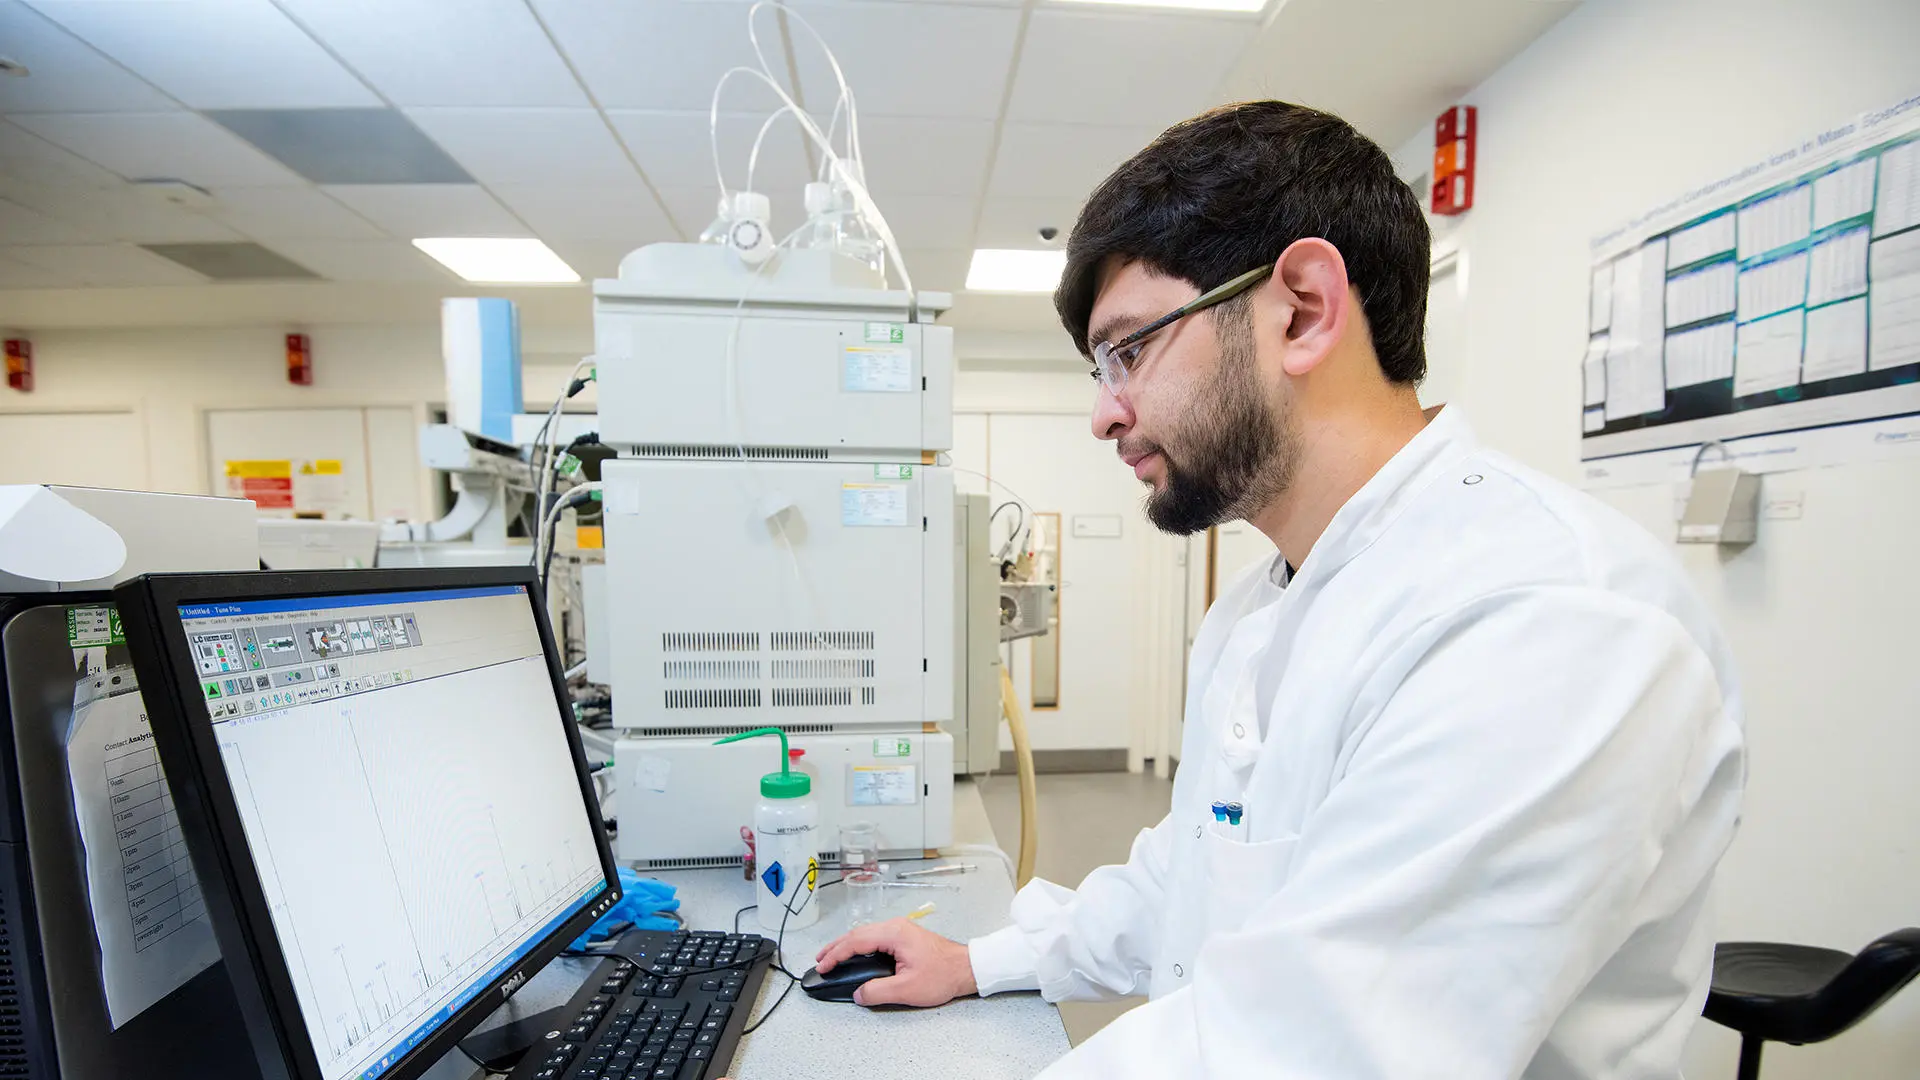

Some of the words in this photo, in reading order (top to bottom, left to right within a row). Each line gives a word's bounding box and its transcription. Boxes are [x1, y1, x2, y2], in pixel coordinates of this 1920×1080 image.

[1817, 123, 1856, 147] Mass
[185, 607, 211, 616] Untitled
[68, 610, 76, 638] PASSED
[104, 740, 129, 751] Contact
[110, 778, 125, 787] 9am
[113, 794, 131, 805] 10am
[116, 811, 134, 822] 11am
[771, 868, 780, 890] 1
[501, 971, 526, 998] DELL
